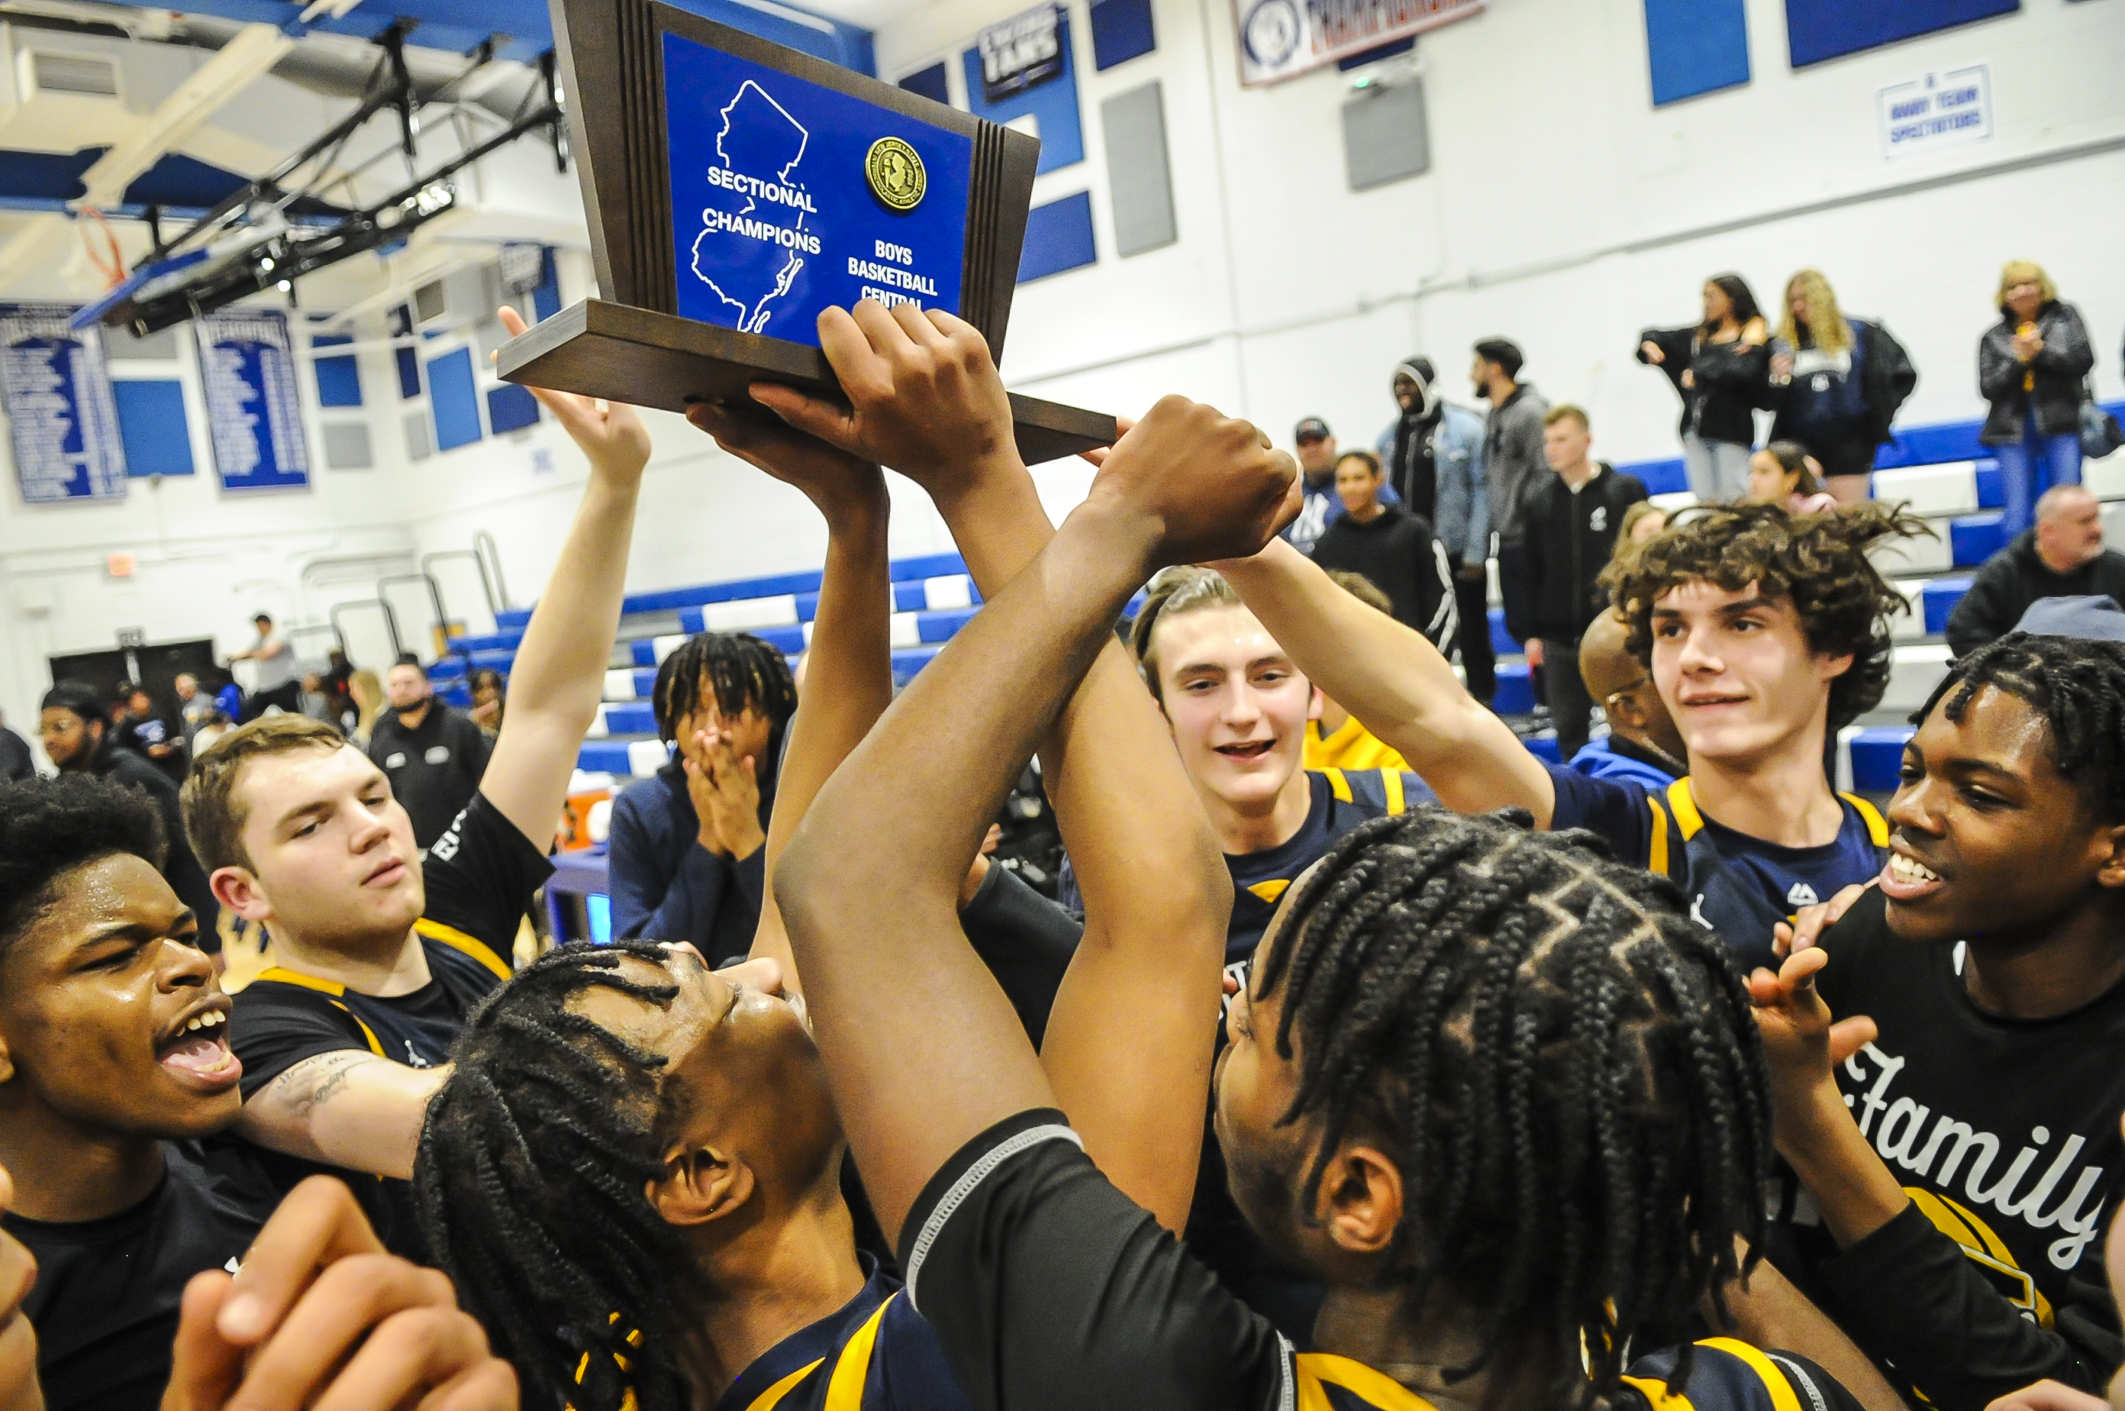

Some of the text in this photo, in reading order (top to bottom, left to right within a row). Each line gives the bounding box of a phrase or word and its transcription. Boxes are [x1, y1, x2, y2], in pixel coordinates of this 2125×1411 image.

[707, 165, 818, 214] SECTIONAL
[702, 207, 822, 255] CHAMPIONS
[875, 239, 913, 266] BOYS
[847, 256, 939, 297] BASKETBALL
[1843, 1040, 2107, 1270] Family
